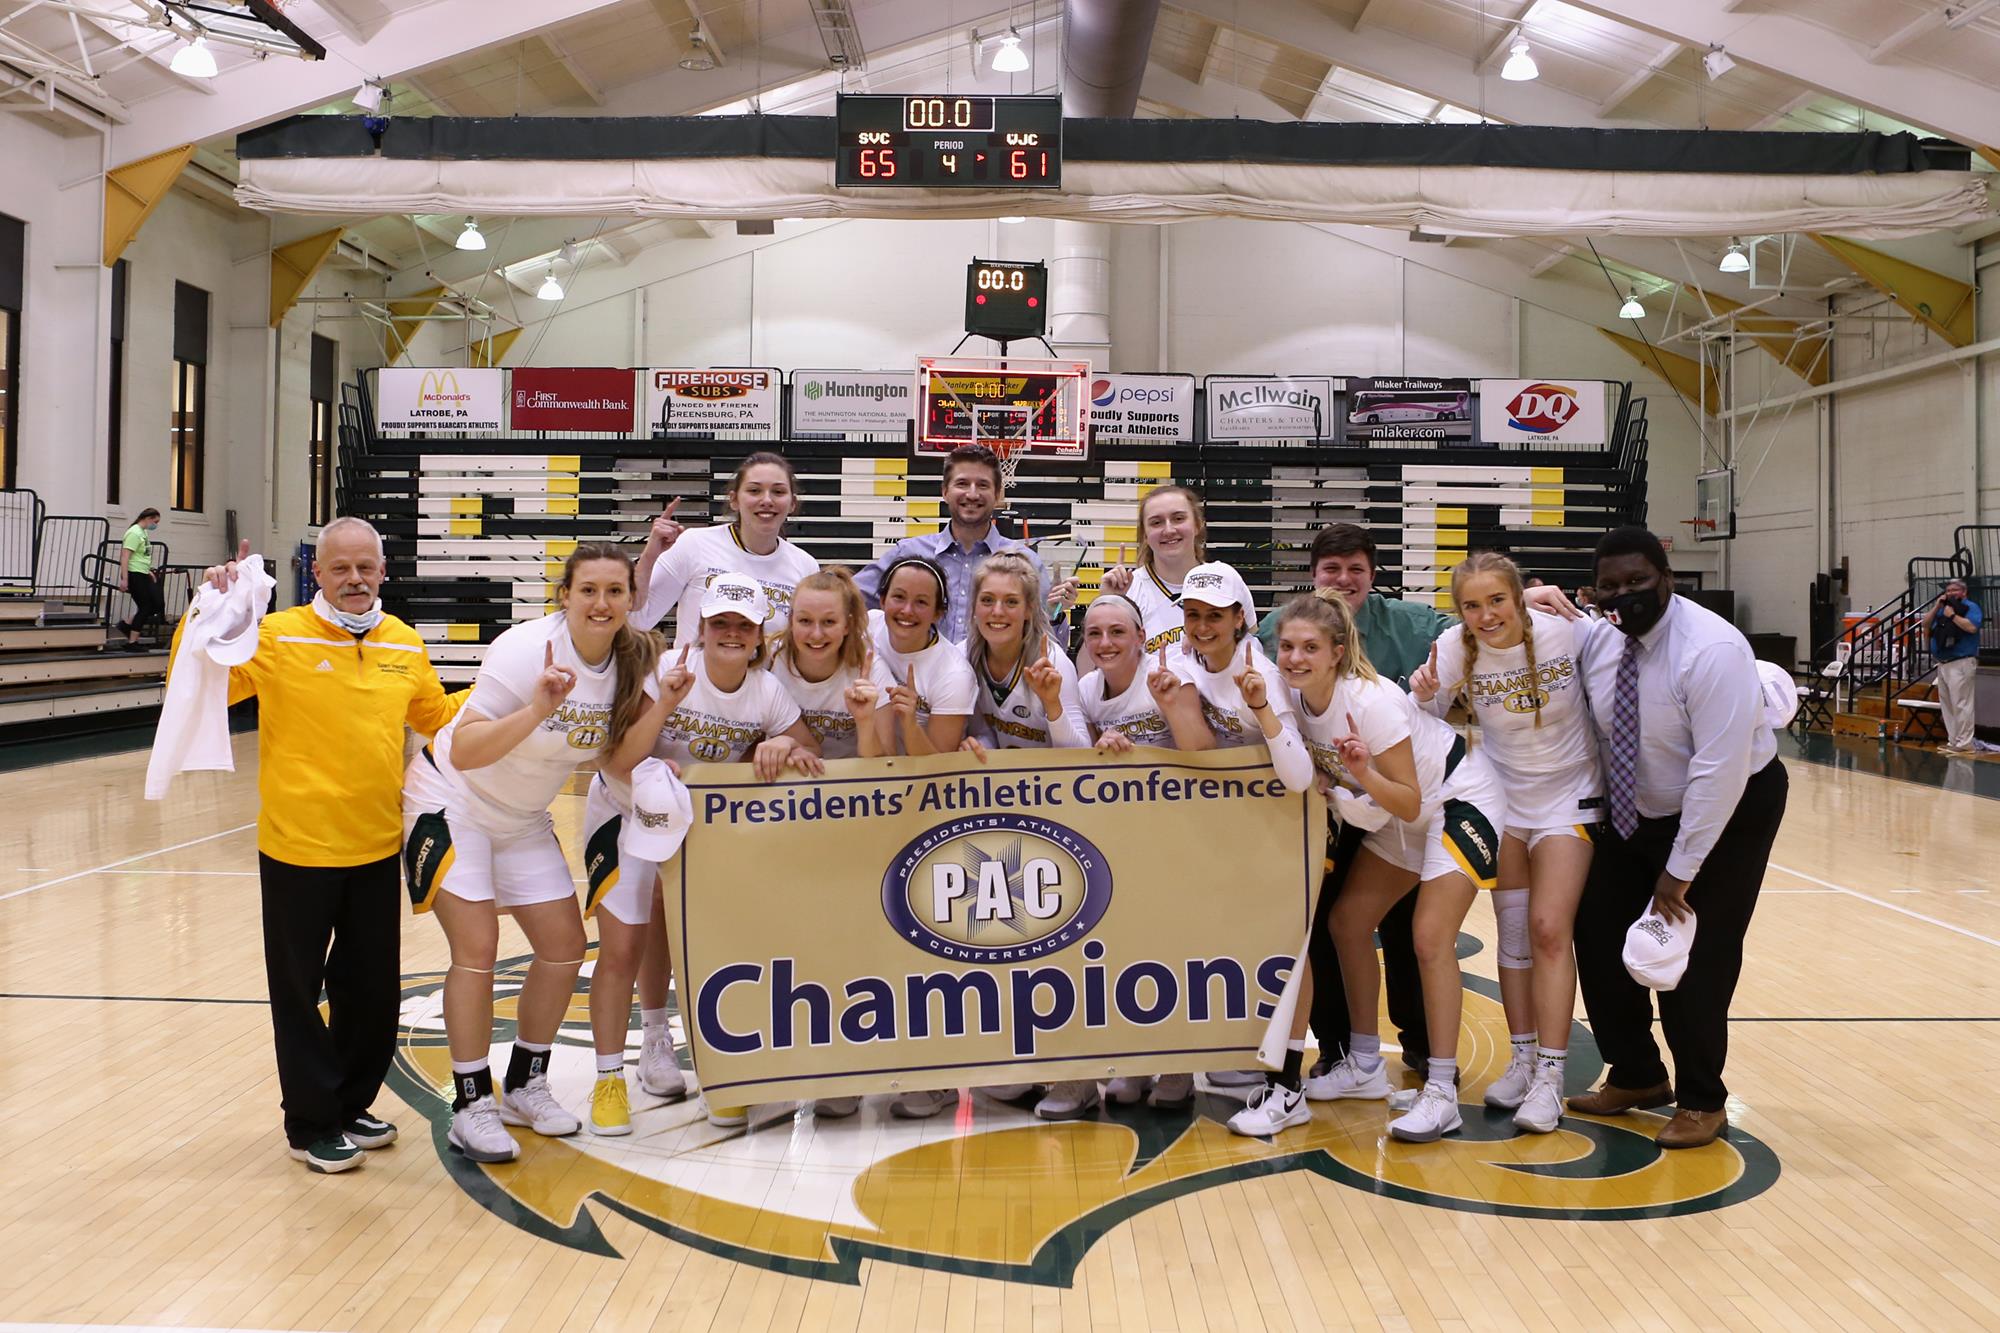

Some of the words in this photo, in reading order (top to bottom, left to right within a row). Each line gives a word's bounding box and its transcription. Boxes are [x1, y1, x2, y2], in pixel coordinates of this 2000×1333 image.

[909, 99, 971, 127] 00.0
[858, 132, 890, 144] SVC
[934, 141, 964, 150] PERIOD
[1006, 133, 1039, 146] WJC
[860, 150, 895, 178] 65
[942, 155, 956, 173] 4
[1011, 150, 1046, 178] 61
[978, 269, 1024, 291] 00.0
[658, 373, 766, 391] FIREHOUSE
[1374, 380, 1403, 389] Mlaker
[1404, 380, 1443, 391] Trailways
[535, 390, 558, 401] FIRST
[691, 386, 731, 397] SUBS
[825, 381, 908, 402] Huntington
[1120, 387, 1174, 405] pepsi
[1219, 386, 1321, 411] McIlwain
[526, 398, 600, 410] Commonwealth
[1515, 393, 1571, 424] DQ
[410, 410, 454, 418] LATROBE,
[669, 410, 737, 419] GREENSBURG,
[739, 410, 754, 418] PA
[1080, 409, 1122, 421] Poudly
[1127, 411, 1180, 423] Supports
[1220, 417, 1273, 425] CHARTERS
[381, 421, 406, 429] PROUDLY
[710, 422, 740, 430] BEARCATS
[740, 422, 771, 430] ATHLETICS
[1127, 424, 1179, 436] Athletics
[1372, 426, 1445, 438] mlaker.com
[1472, 660, 1574, 696] CHAMPONS
[573, 731, 602, 745] PAC
[695, 741, 725, 757] PAC
[704, 784, 914, 824] Presidents'
[918, 776, 1062, 811] Athletic
[1072, 769, 1287, 804] Conference
[899, 817, 1006, 878] PRESIDENTS'
[1017, 819, 1093, 870] ATHLETIC
[1459, 820, 1492, 866] BEARCATS
[932, 857, 1061, 922] PAC
[930, 932, 1070, 960] CONFERENCE
[697, 939, 1298, 1056] Champions
